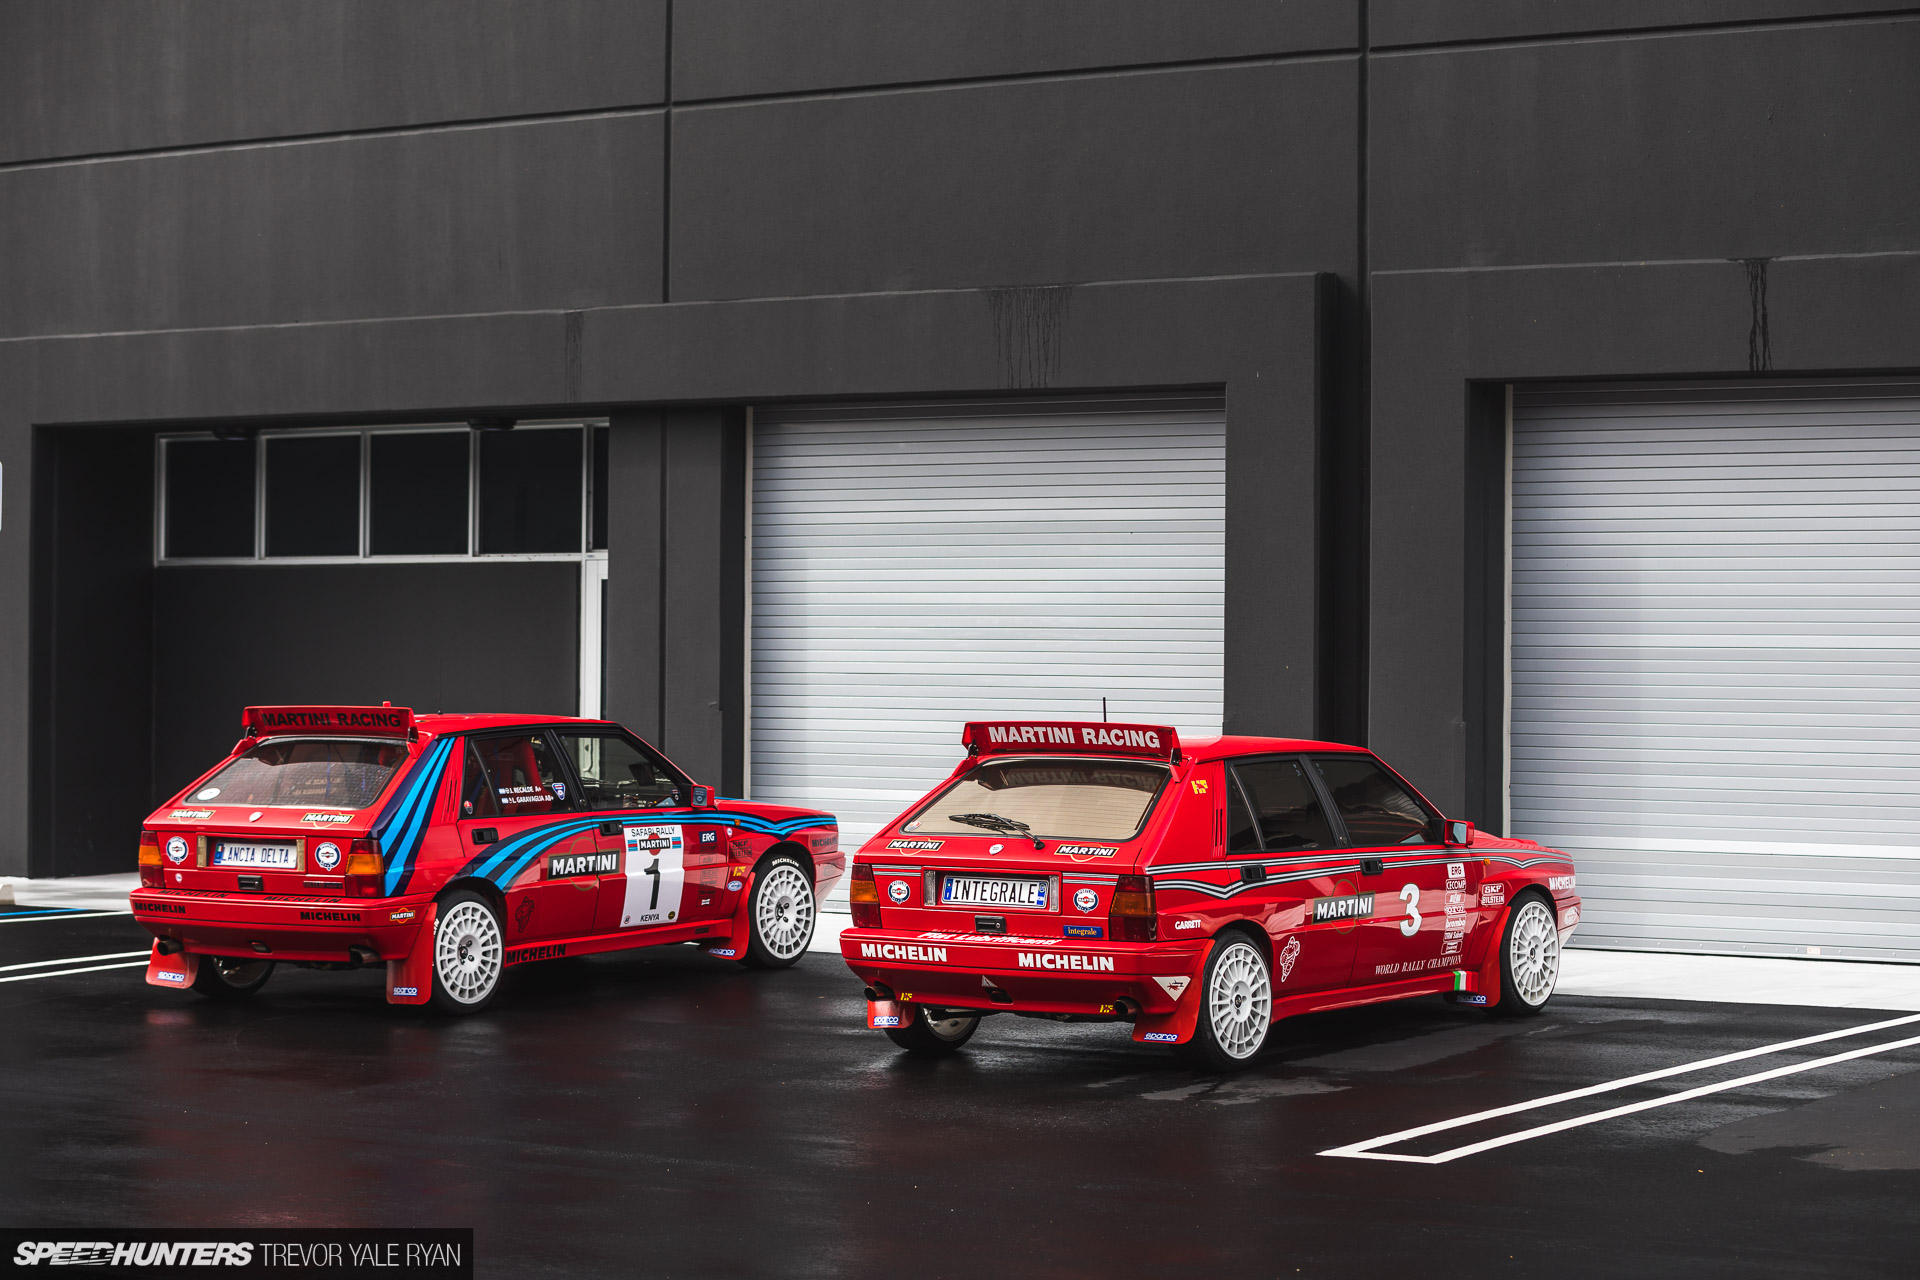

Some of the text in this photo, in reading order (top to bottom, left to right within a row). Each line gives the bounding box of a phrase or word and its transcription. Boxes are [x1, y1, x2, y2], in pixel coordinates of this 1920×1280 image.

[262, 713, 401, 728] MARTINI RACING
[988, 726, 1161, 748] MARTINI RACING
[170, 810, 213, 819] MARTINI
[304, 813, 351, 823] MARTINI
[631, 827, 675, 837] SAFARI RALLY
[702, 833, 715, 842] ERG
[812, 837, 837, 847] MICHELIN
[640, 838, 670, 849] MARTINI
[890, 840, 940, 850] MARTINI
[221, 846, 289, 864] LANCIA DELTA
[1059, 845, 1114, 856] MARTINI
[552, 853, 617, 876] MARTINI
[772, 857, 800, 868] MICHELIN
[1451, 866, 1462, 876] ERG
[643, 858, 661, 911] 1
[1446, 880, 1466, 890] CECOMP
[1484, 885, 1502, 893] SKF
[158, 889, 230, 899] MICHELIN
[953, 879, 1038, 905] INTEGRALE
[264, 895, 342, 904] MICHELIN
[1481, 895, 1505, 904] BILSTEIN
[134, 902, 186, 914] MICHELIN
[1316, 896, 1373, 921] MARTINI
[1399, 883, 1422, 938] 3
[300, 911, 361, 922] MICHELIN
[391, 911, 414, 920] MARTINI
[640, 913, 660, 922] KENYA
[1175, 919, 1201, 930] GARRETT
[1445, 918, 1466, 928] brembo
[1067, 926, 1097, 936] integrale
[506, 943, 566, 965] MICHELIN
[861, 943, 948, 963] MICHELIN
[1018, 952, 1115, 972] MICHELIN
[1375, 954, 1463, 976] WORLD RALLY CHAMPION
[393, 987, 418, 996] sparco
[1144, 1032, 1178, 1042] sparco
